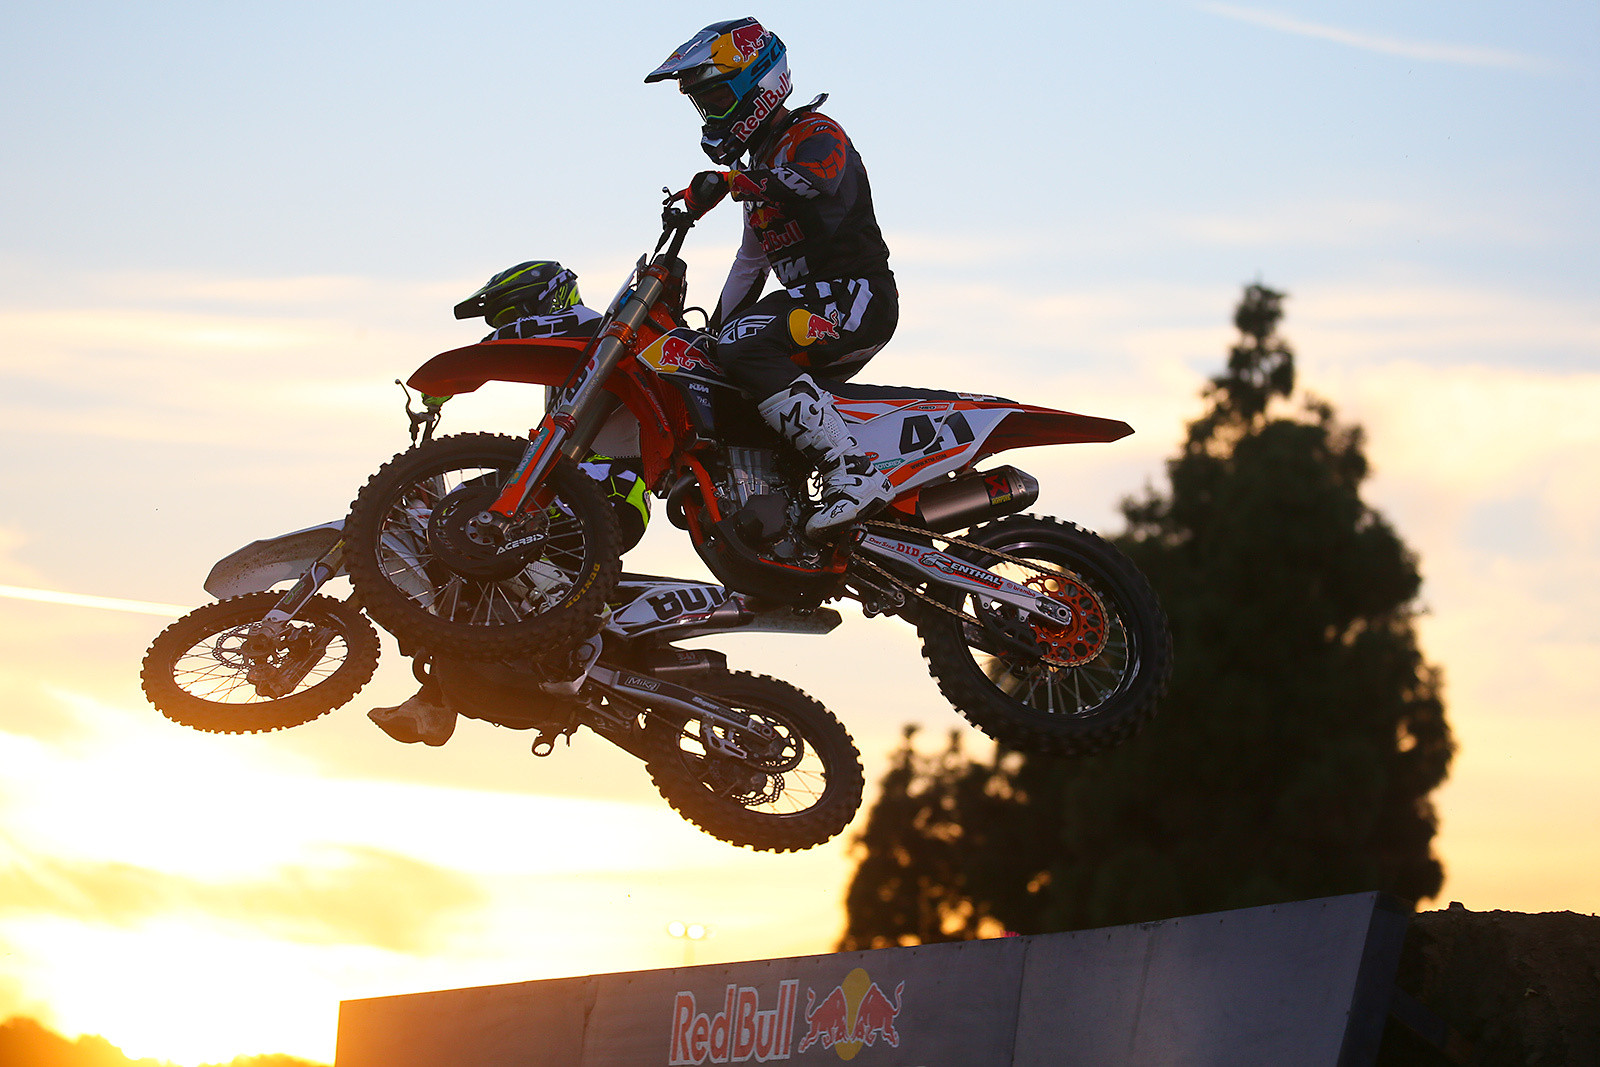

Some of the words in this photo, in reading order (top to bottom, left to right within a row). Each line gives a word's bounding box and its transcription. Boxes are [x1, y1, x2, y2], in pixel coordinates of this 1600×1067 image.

[730, 93, 771, 142] Red
[762, 72, 790, 113] Bull
[771, 166, 820, 198] KTM
[772, 255, 809, 283] TM
[688, 382, 710, 394] KTM
[899, 412, 975, 455] 41
[909, 453, 948, 470] WWW.KTM.COM
[496, 533, 545, 555] ACERBIS
[565, 563, 600, 608] DUNLOP
[897, 542, 921, 558] DID
[1012, 583, 1037, 598] brembo
[668, 984, 736, 1065] Red
[731, 979, 800, 1063] Bull
